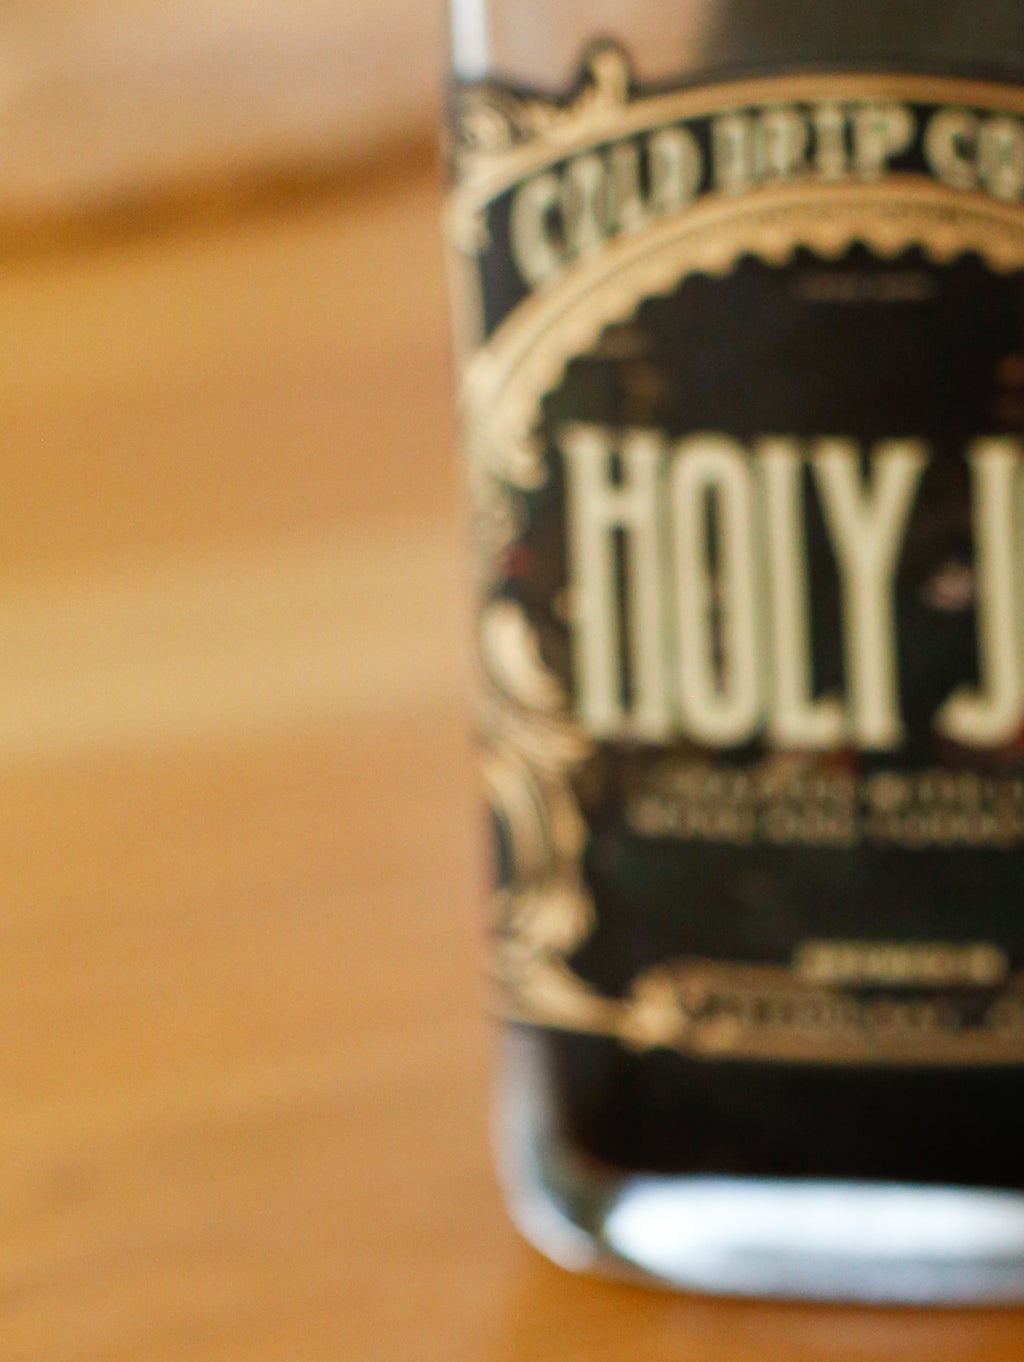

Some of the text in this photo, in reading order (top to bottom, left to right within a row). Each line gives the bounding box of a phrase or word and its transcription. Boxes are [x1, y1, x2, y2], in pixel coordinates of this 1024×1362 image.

[511, 126, 703, 288] COLD
[712, 102, 915, 186] DRIP
[564, 426, 926, 750] HOLY
